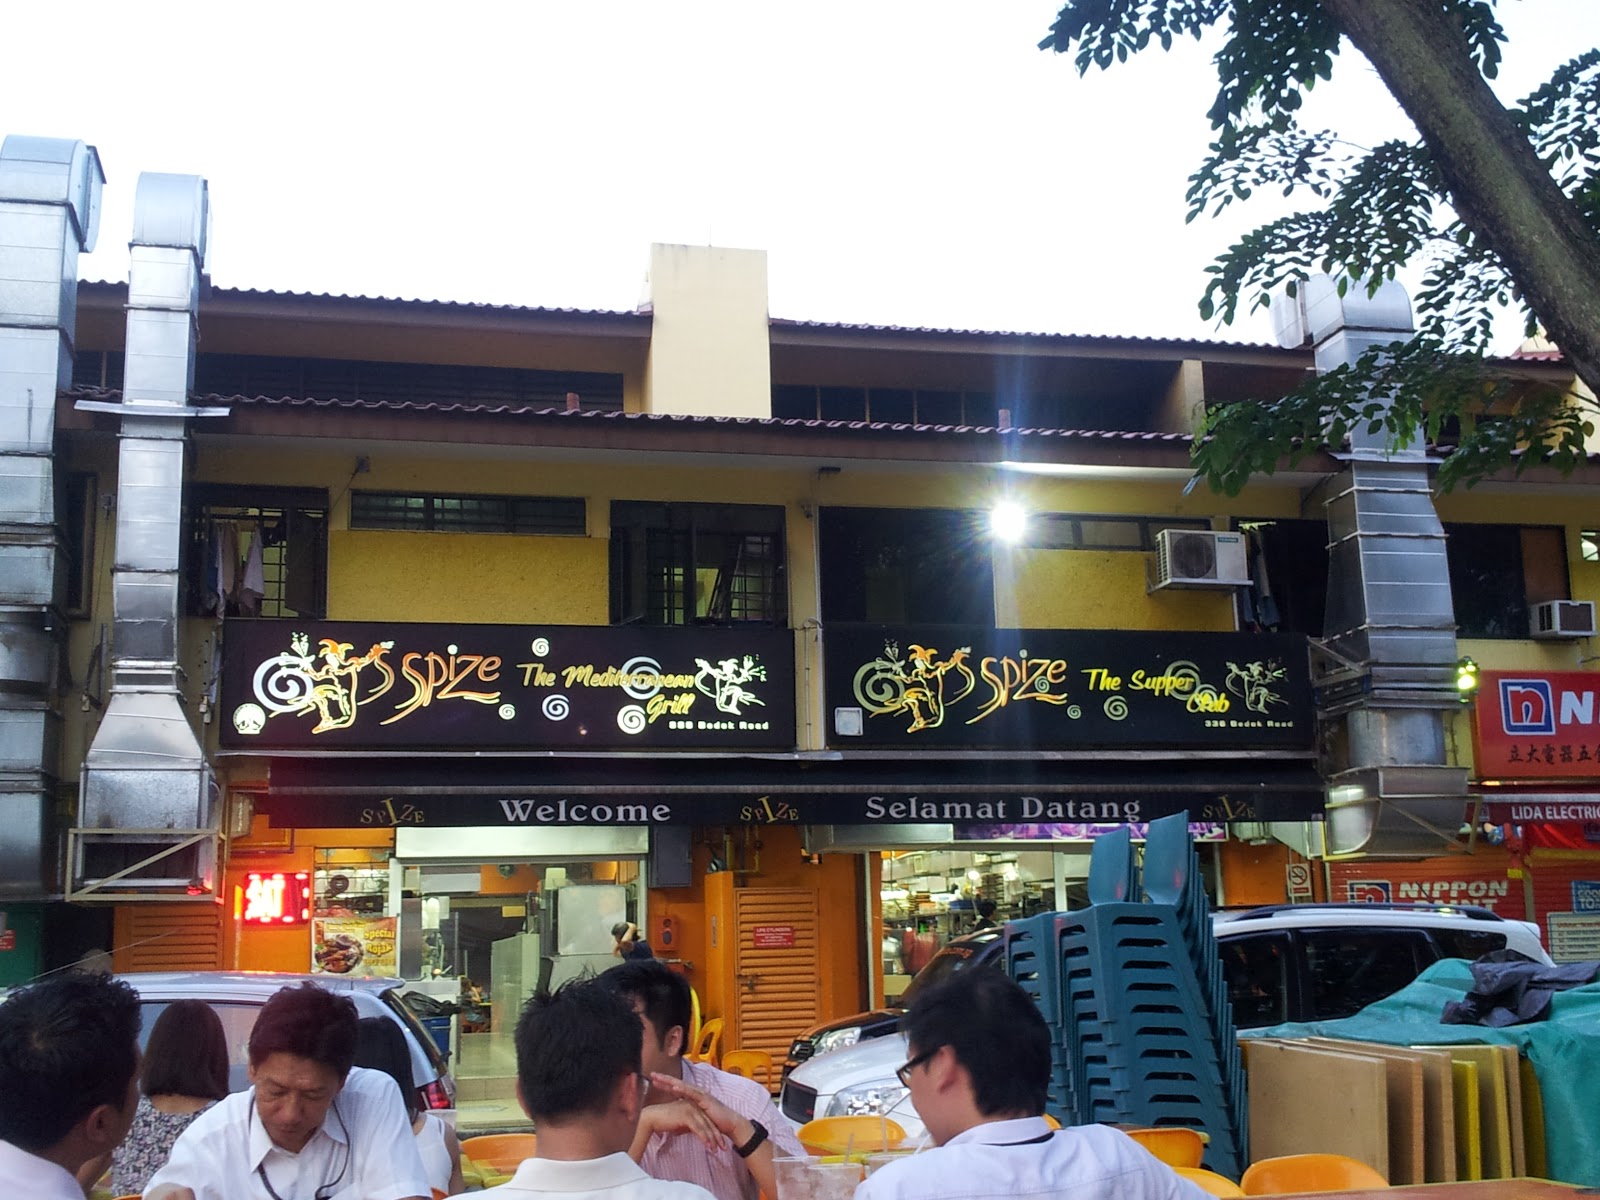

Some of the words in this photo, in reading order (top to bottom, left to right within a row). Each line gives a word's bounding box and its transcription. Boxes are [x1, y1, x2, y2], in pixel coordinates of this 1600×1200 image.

[516, 663, 556, 687] The
[561, 664, 696, 688] Mediterranean
[1081, 668, 1121, 691] The
[1128, 669, 1195, 697] Supper
[646, 692, 696, 724] Grill
[360, 797, 425, 826] SPIZE
[499, 799, 671, 822] Welcome
[740, 795, 799, 823] SPIZE
[865, 797, 1007, 819] Selamat
[1021, 797, 1140, 822] Datang
[1511, 805, 1543, 820] LIDA
[1399, 880, 1508, 898] NIPPON
[364, 928, 395, 940] Special
